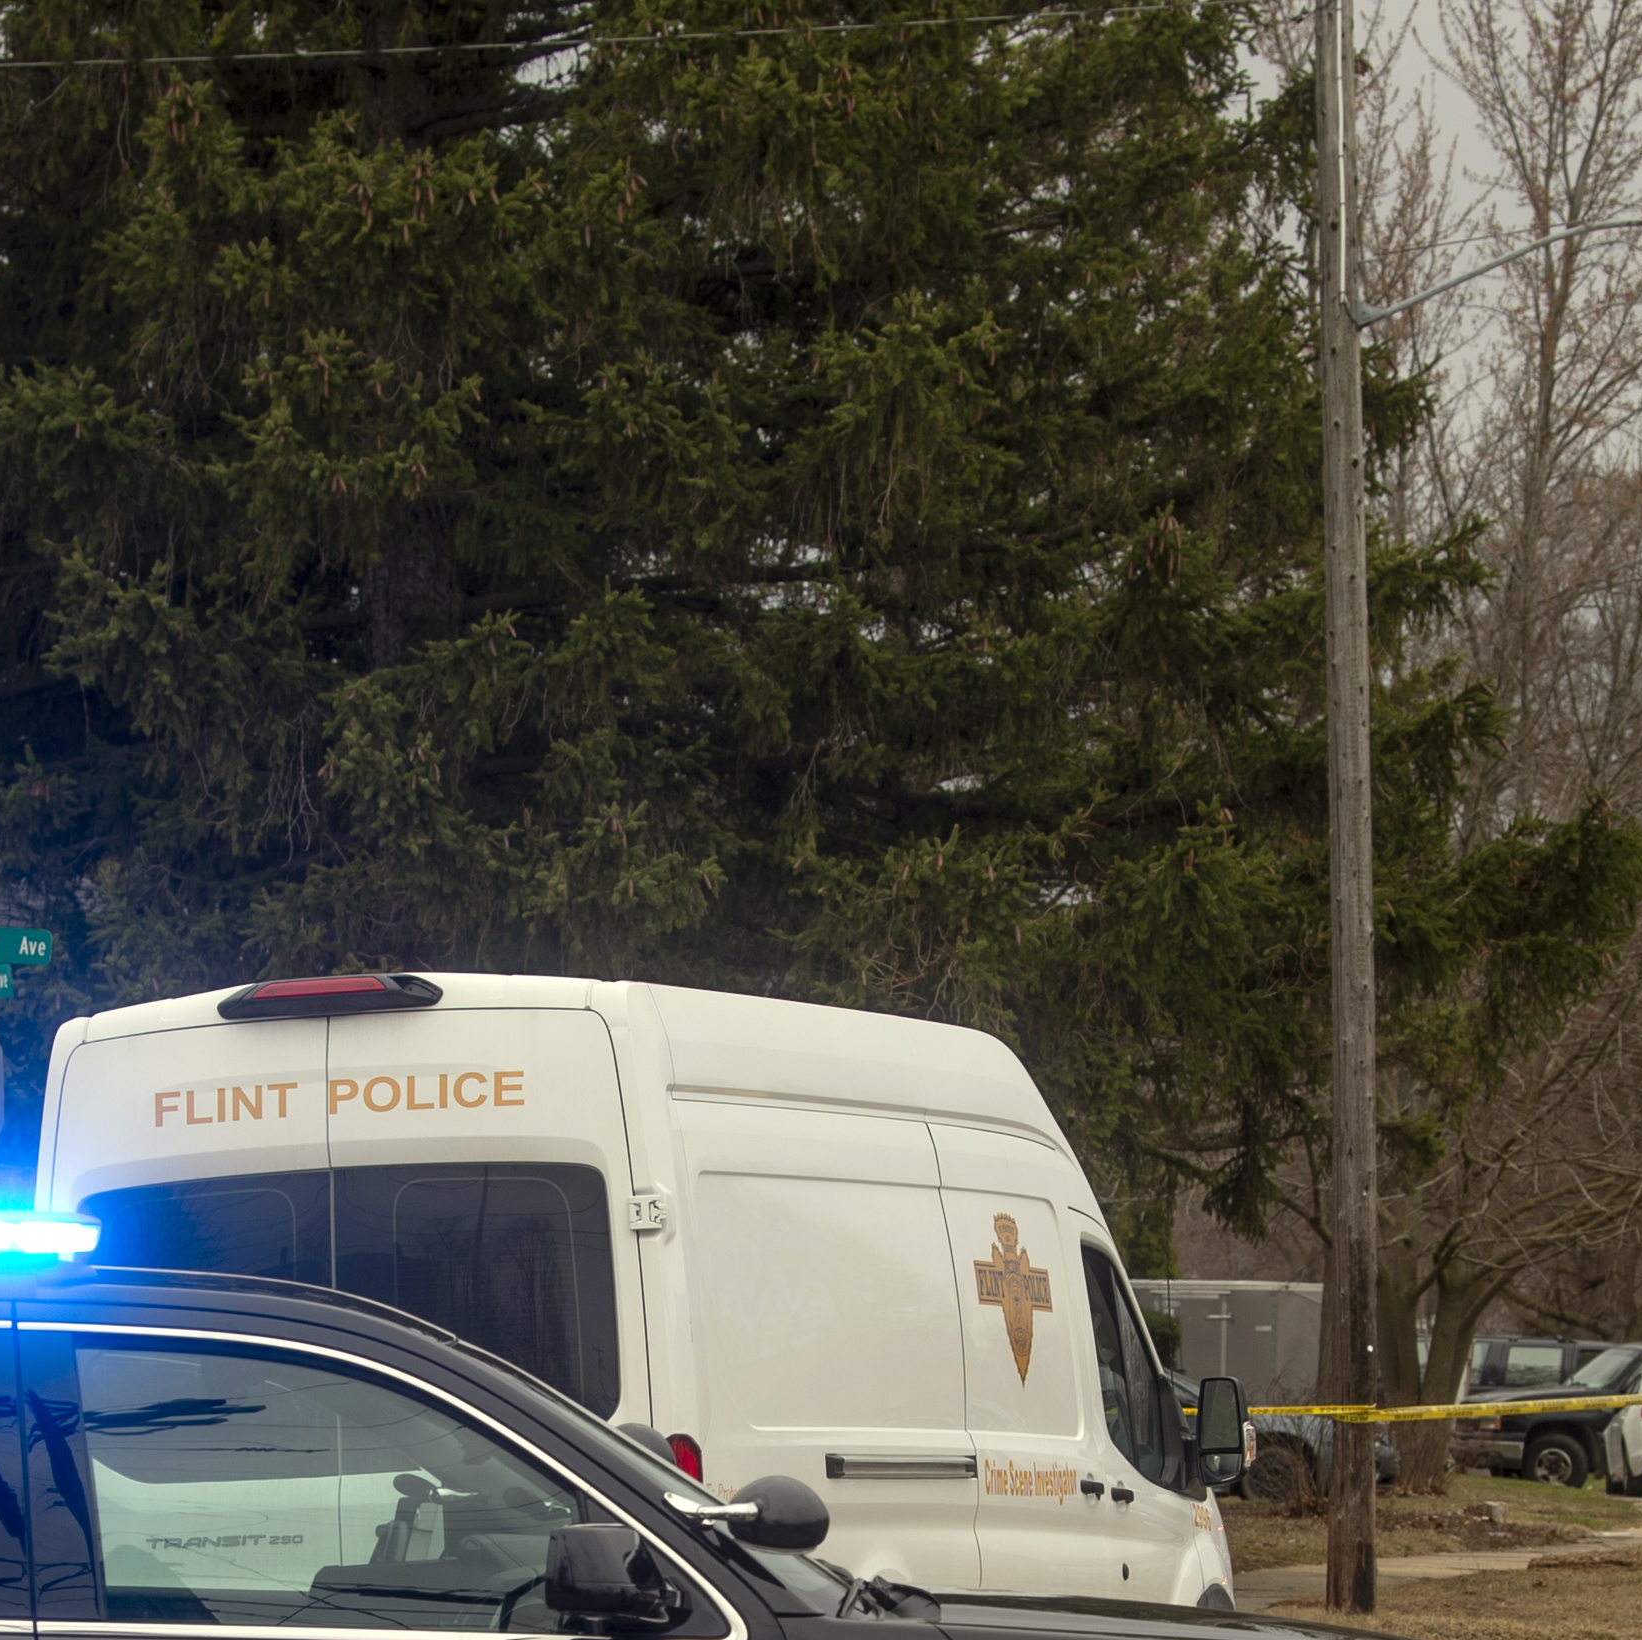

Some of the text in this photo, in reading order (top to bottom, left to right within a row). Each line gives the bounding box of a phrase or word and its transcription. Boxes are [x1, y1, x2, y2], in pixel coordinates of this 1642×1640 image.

[19, 936, 47, 957] Ave
[154, 1070, 526, 1128] FLINT POLICE
[977, 1269, 1050, 1304] FLINT POLICE
[984, 1459, 1077, 1506] Crime Scene Investigator
[145, 1534, 304, 1550] TRANSIT 250
